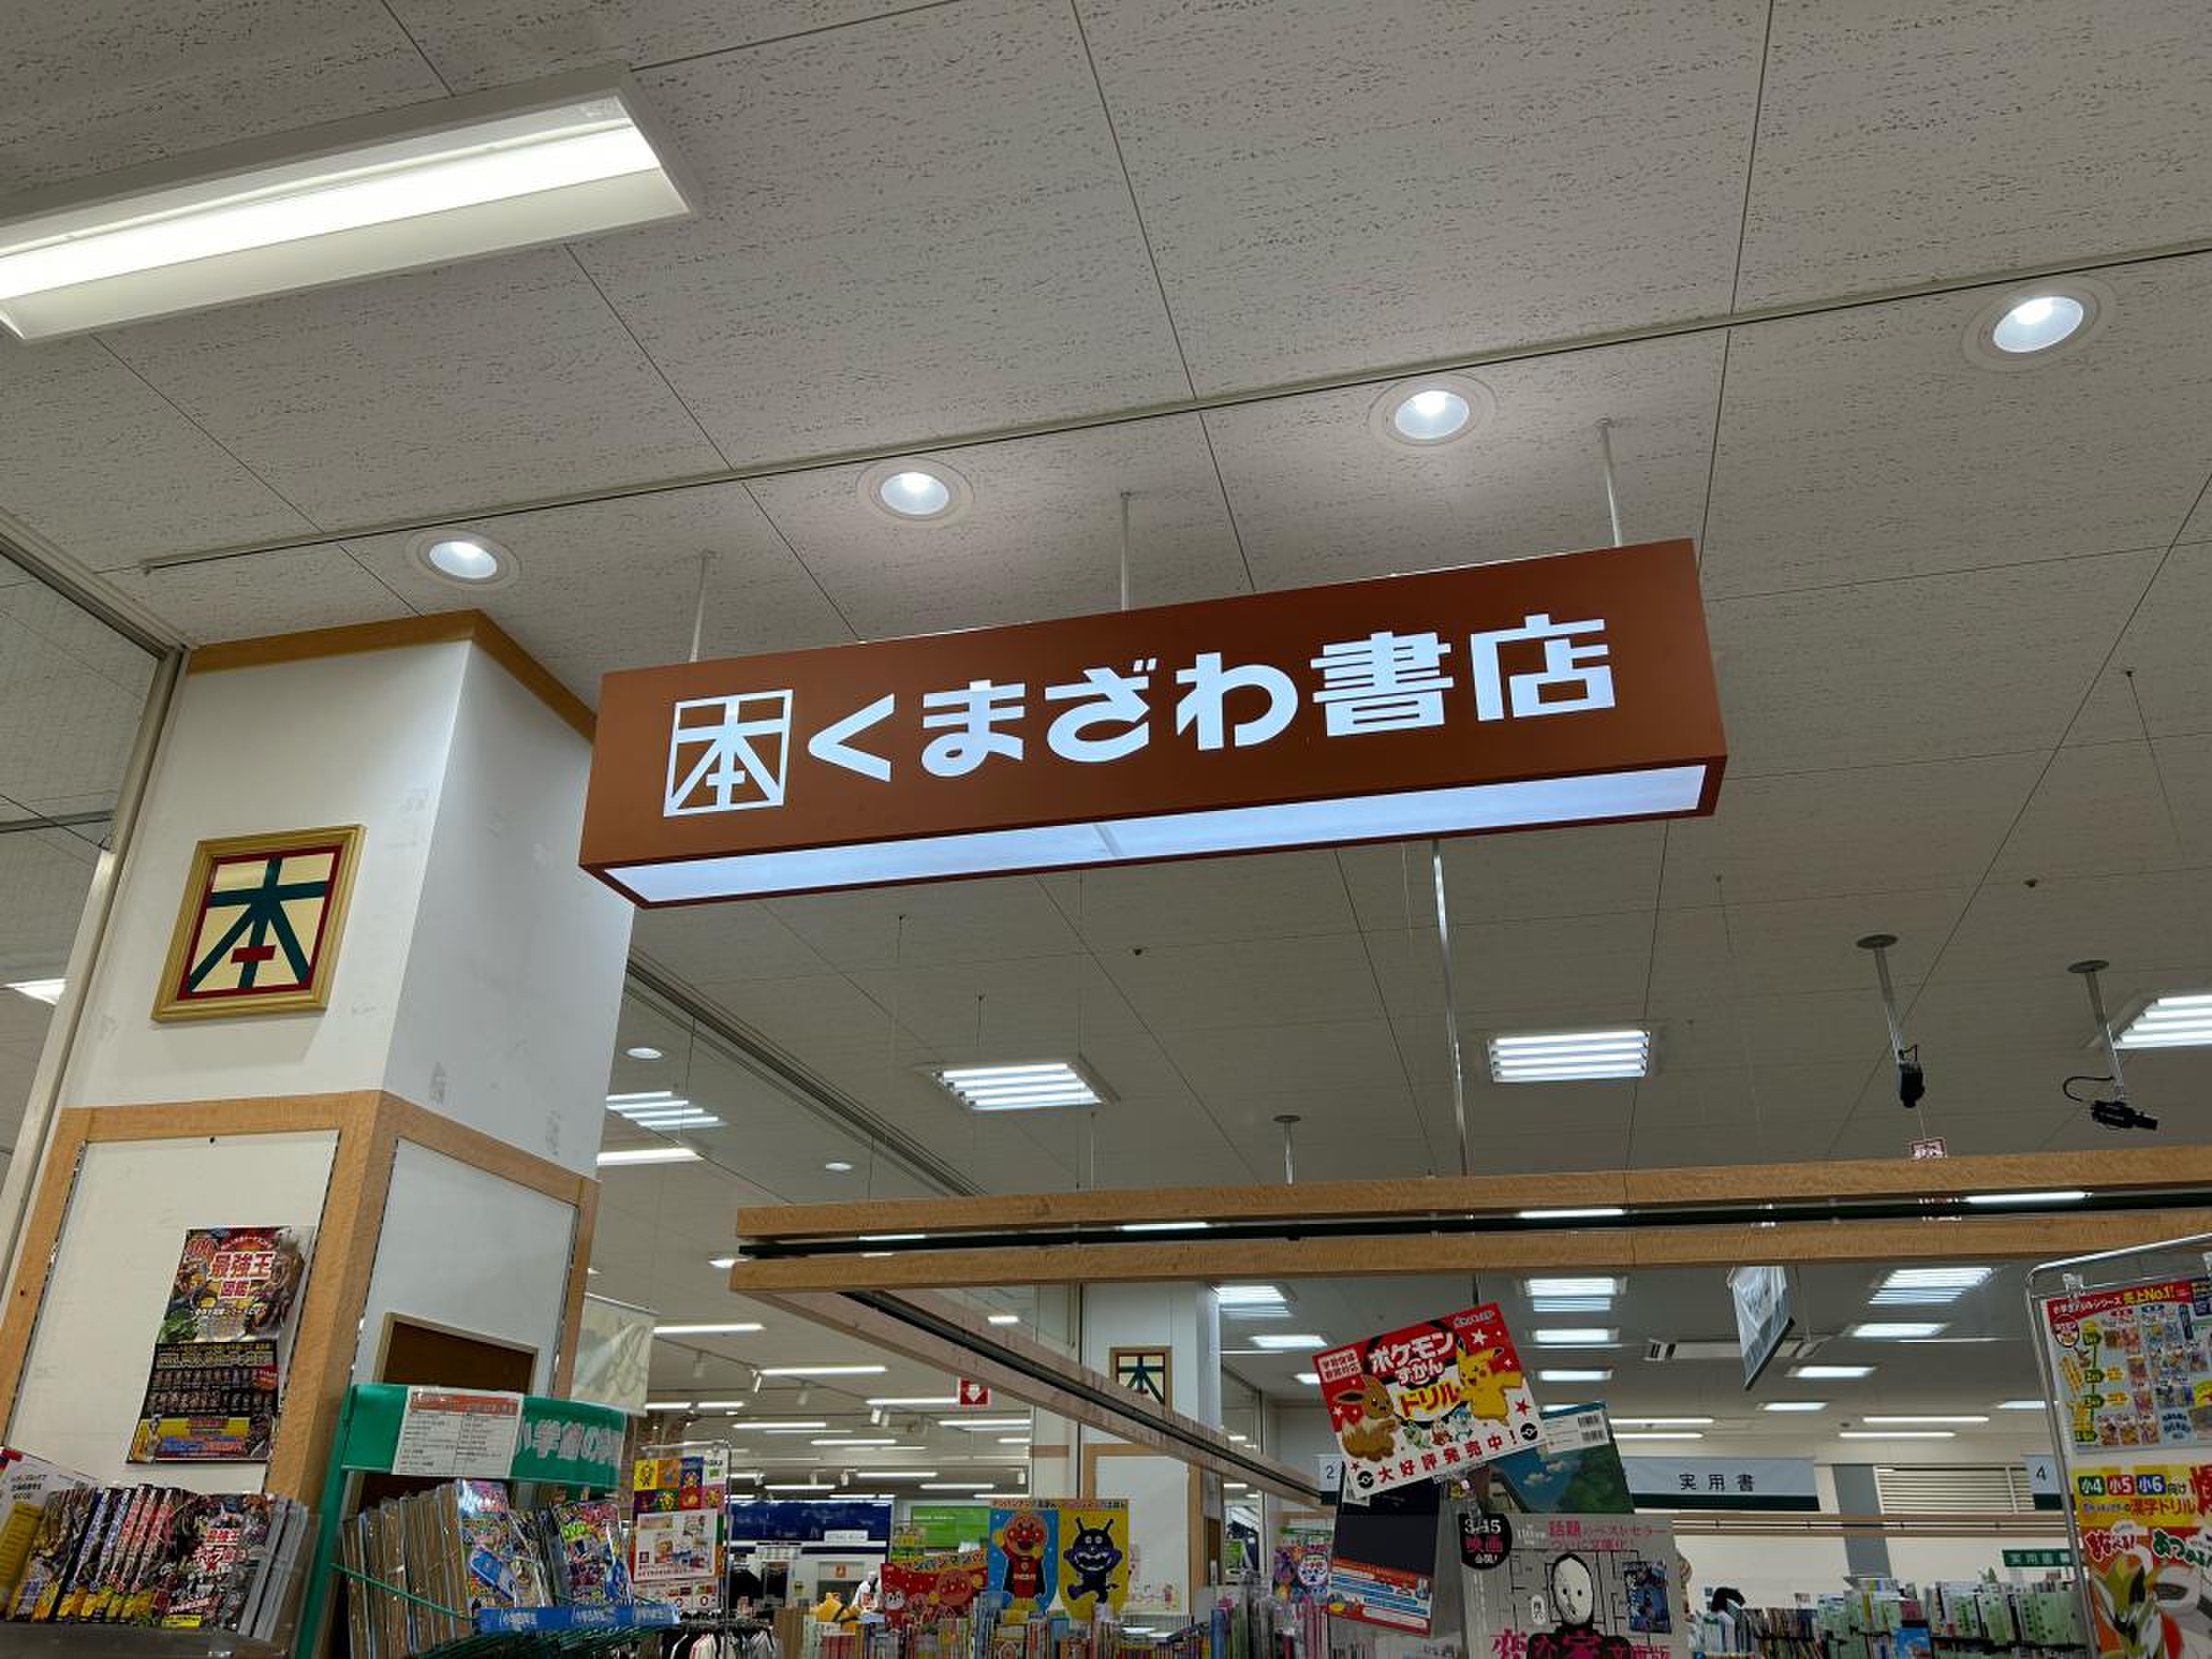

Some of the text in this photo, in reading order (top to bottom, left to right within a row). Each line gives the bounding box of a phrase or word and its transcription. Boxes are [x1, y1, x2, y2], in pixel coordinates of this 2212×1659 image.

[807, 612, 1617, 783] くまざわ書店
[1368, 1330, 1454, 1373] ポケモン
[1396, 1359, 1446, 1384] ずかん
[1400, 1380, 1462, 1419] ドリル
[1377, 1430, 1519, 1483] 大好評発売中!
[1325, 1465, 1335, 1479] 2
[1678, 1473, 1756, 1492] 実用書
[2035, 1465, 2047, 1480] 4
[2136, 1475, 2165, 1495] 小6
